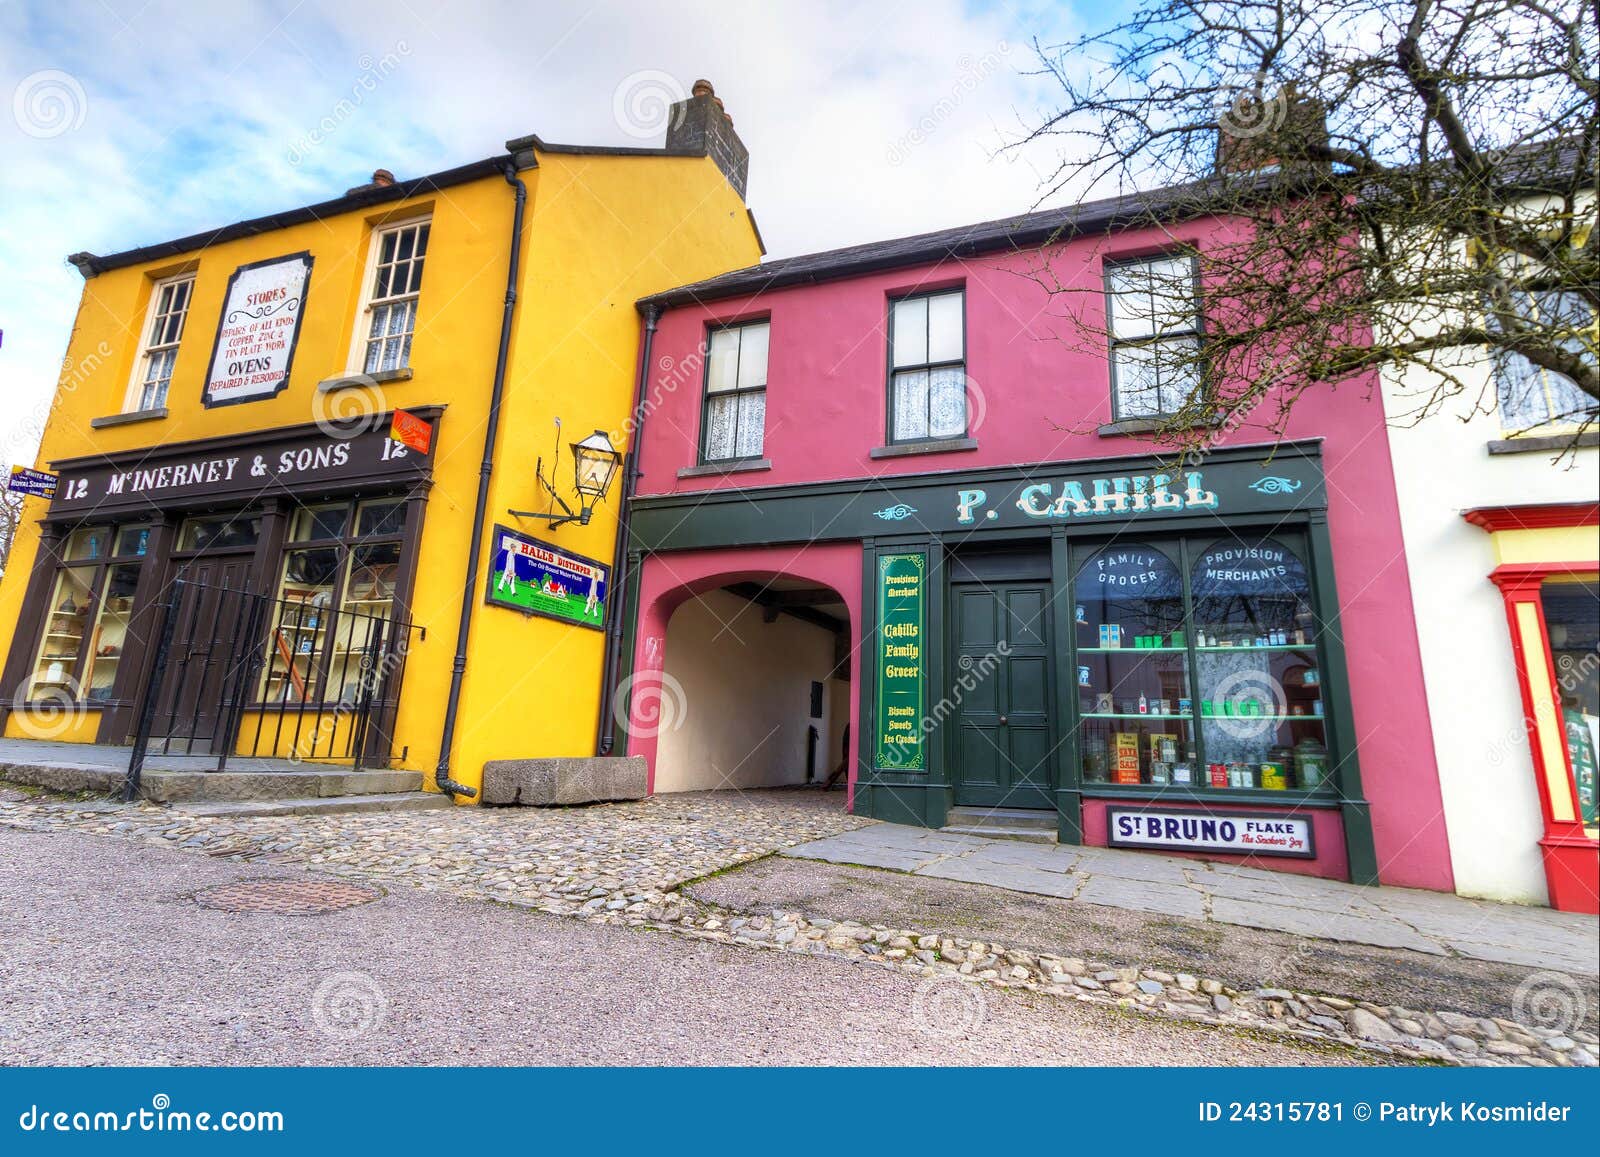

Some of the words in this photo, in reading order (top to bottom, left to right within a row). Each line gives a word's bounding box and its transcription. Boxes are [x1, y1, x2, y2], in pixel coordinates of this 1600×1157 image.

[246, 287, 288, 307] STORES
[261, 320, 272, 330] ALL
[275, 316, 295, 327] KINDS
[228, 334, 254, 348] COPPER
[258, 331, 275, 342] ZINC
[225, 349, 238, 359] TIN
[239, 343, 263, 356] PLATE
[265, 339, 286, 351] WORK
[228, 356, 271, 376] OVENS
[208, 377, 243, 392] REPAIRED
[64, 478, 89, 500] 12
[250, 455, 268, 477] &
[277, 442, 350, 474] SONS
[957, 489, 999, 524] P.
[1015, 471, 1219, 521] CAHILL
[557, 556, 591, 576] DISTEMPER
[1097, 553, 1156, 570] FAMILY
[1206, 549, 1284, 566] PROVISION
[1098, 571, 1157, 586] GROCER
[1206, 566, 1287, 581] MERCHANTS
[887, 587, 918, 598] Merchant
[884, 623, 919, 639] Cahills
[885, 643, 919, 660] Family
[885, 664, 919, 679] Grocer
[888, 706, 915, 717] Biscuits
[888, 720, 913, 732] Sweets
[1146, 817, 1236, 842] BRUNO
[1246, 822, 1295, 834] FLAKE
[1241, 833, 1253, 843] The
[1289, 836, 1304, 849] Joy
